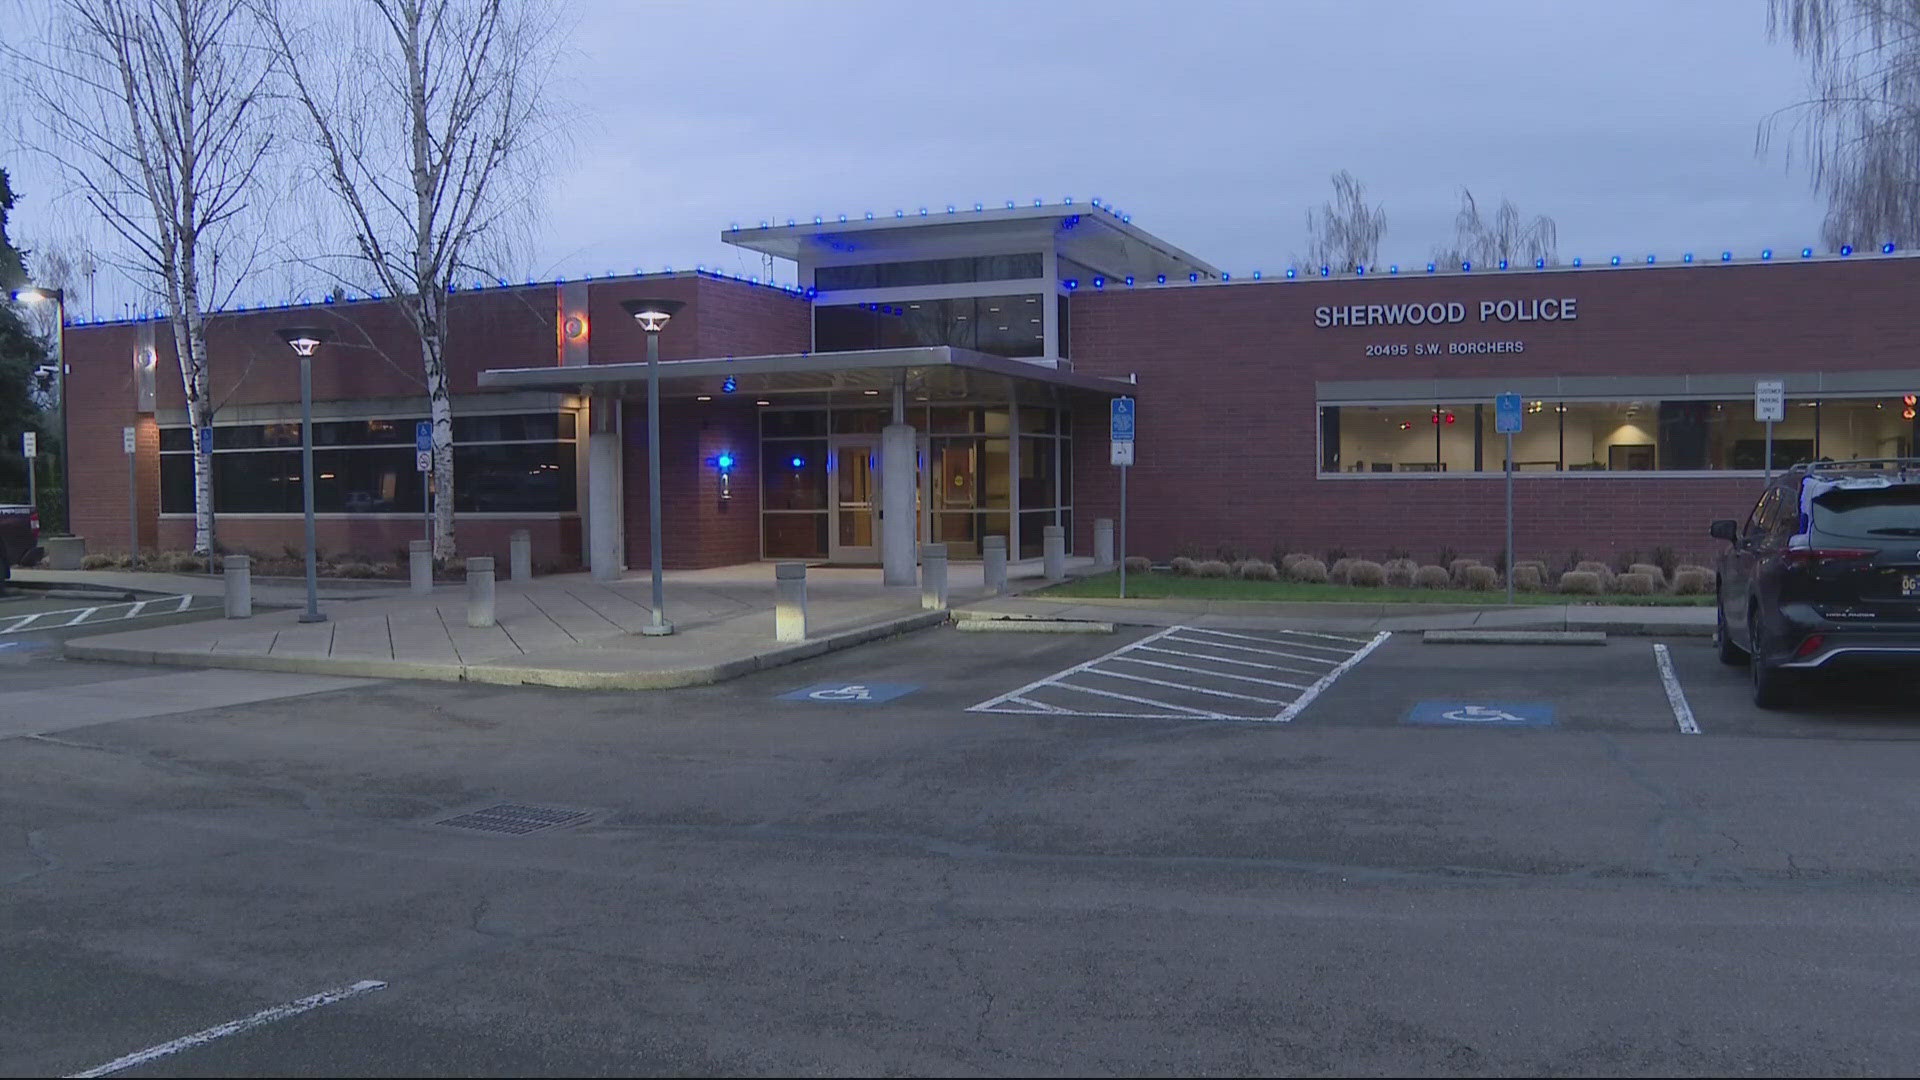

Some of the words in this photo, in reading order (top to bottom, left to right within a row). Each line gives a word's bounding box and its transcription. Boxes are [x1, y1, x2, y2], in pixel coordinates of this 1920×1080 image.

[1315, 303, 1465, 327] SHERWOOD
[1480, 299, 1577, 321] POLICE
[1366, 344, 1408, 356] 20495
[1415, 343, 1442, 355] S.W.
[1449, 341, 1524, 354] BORCHERS
